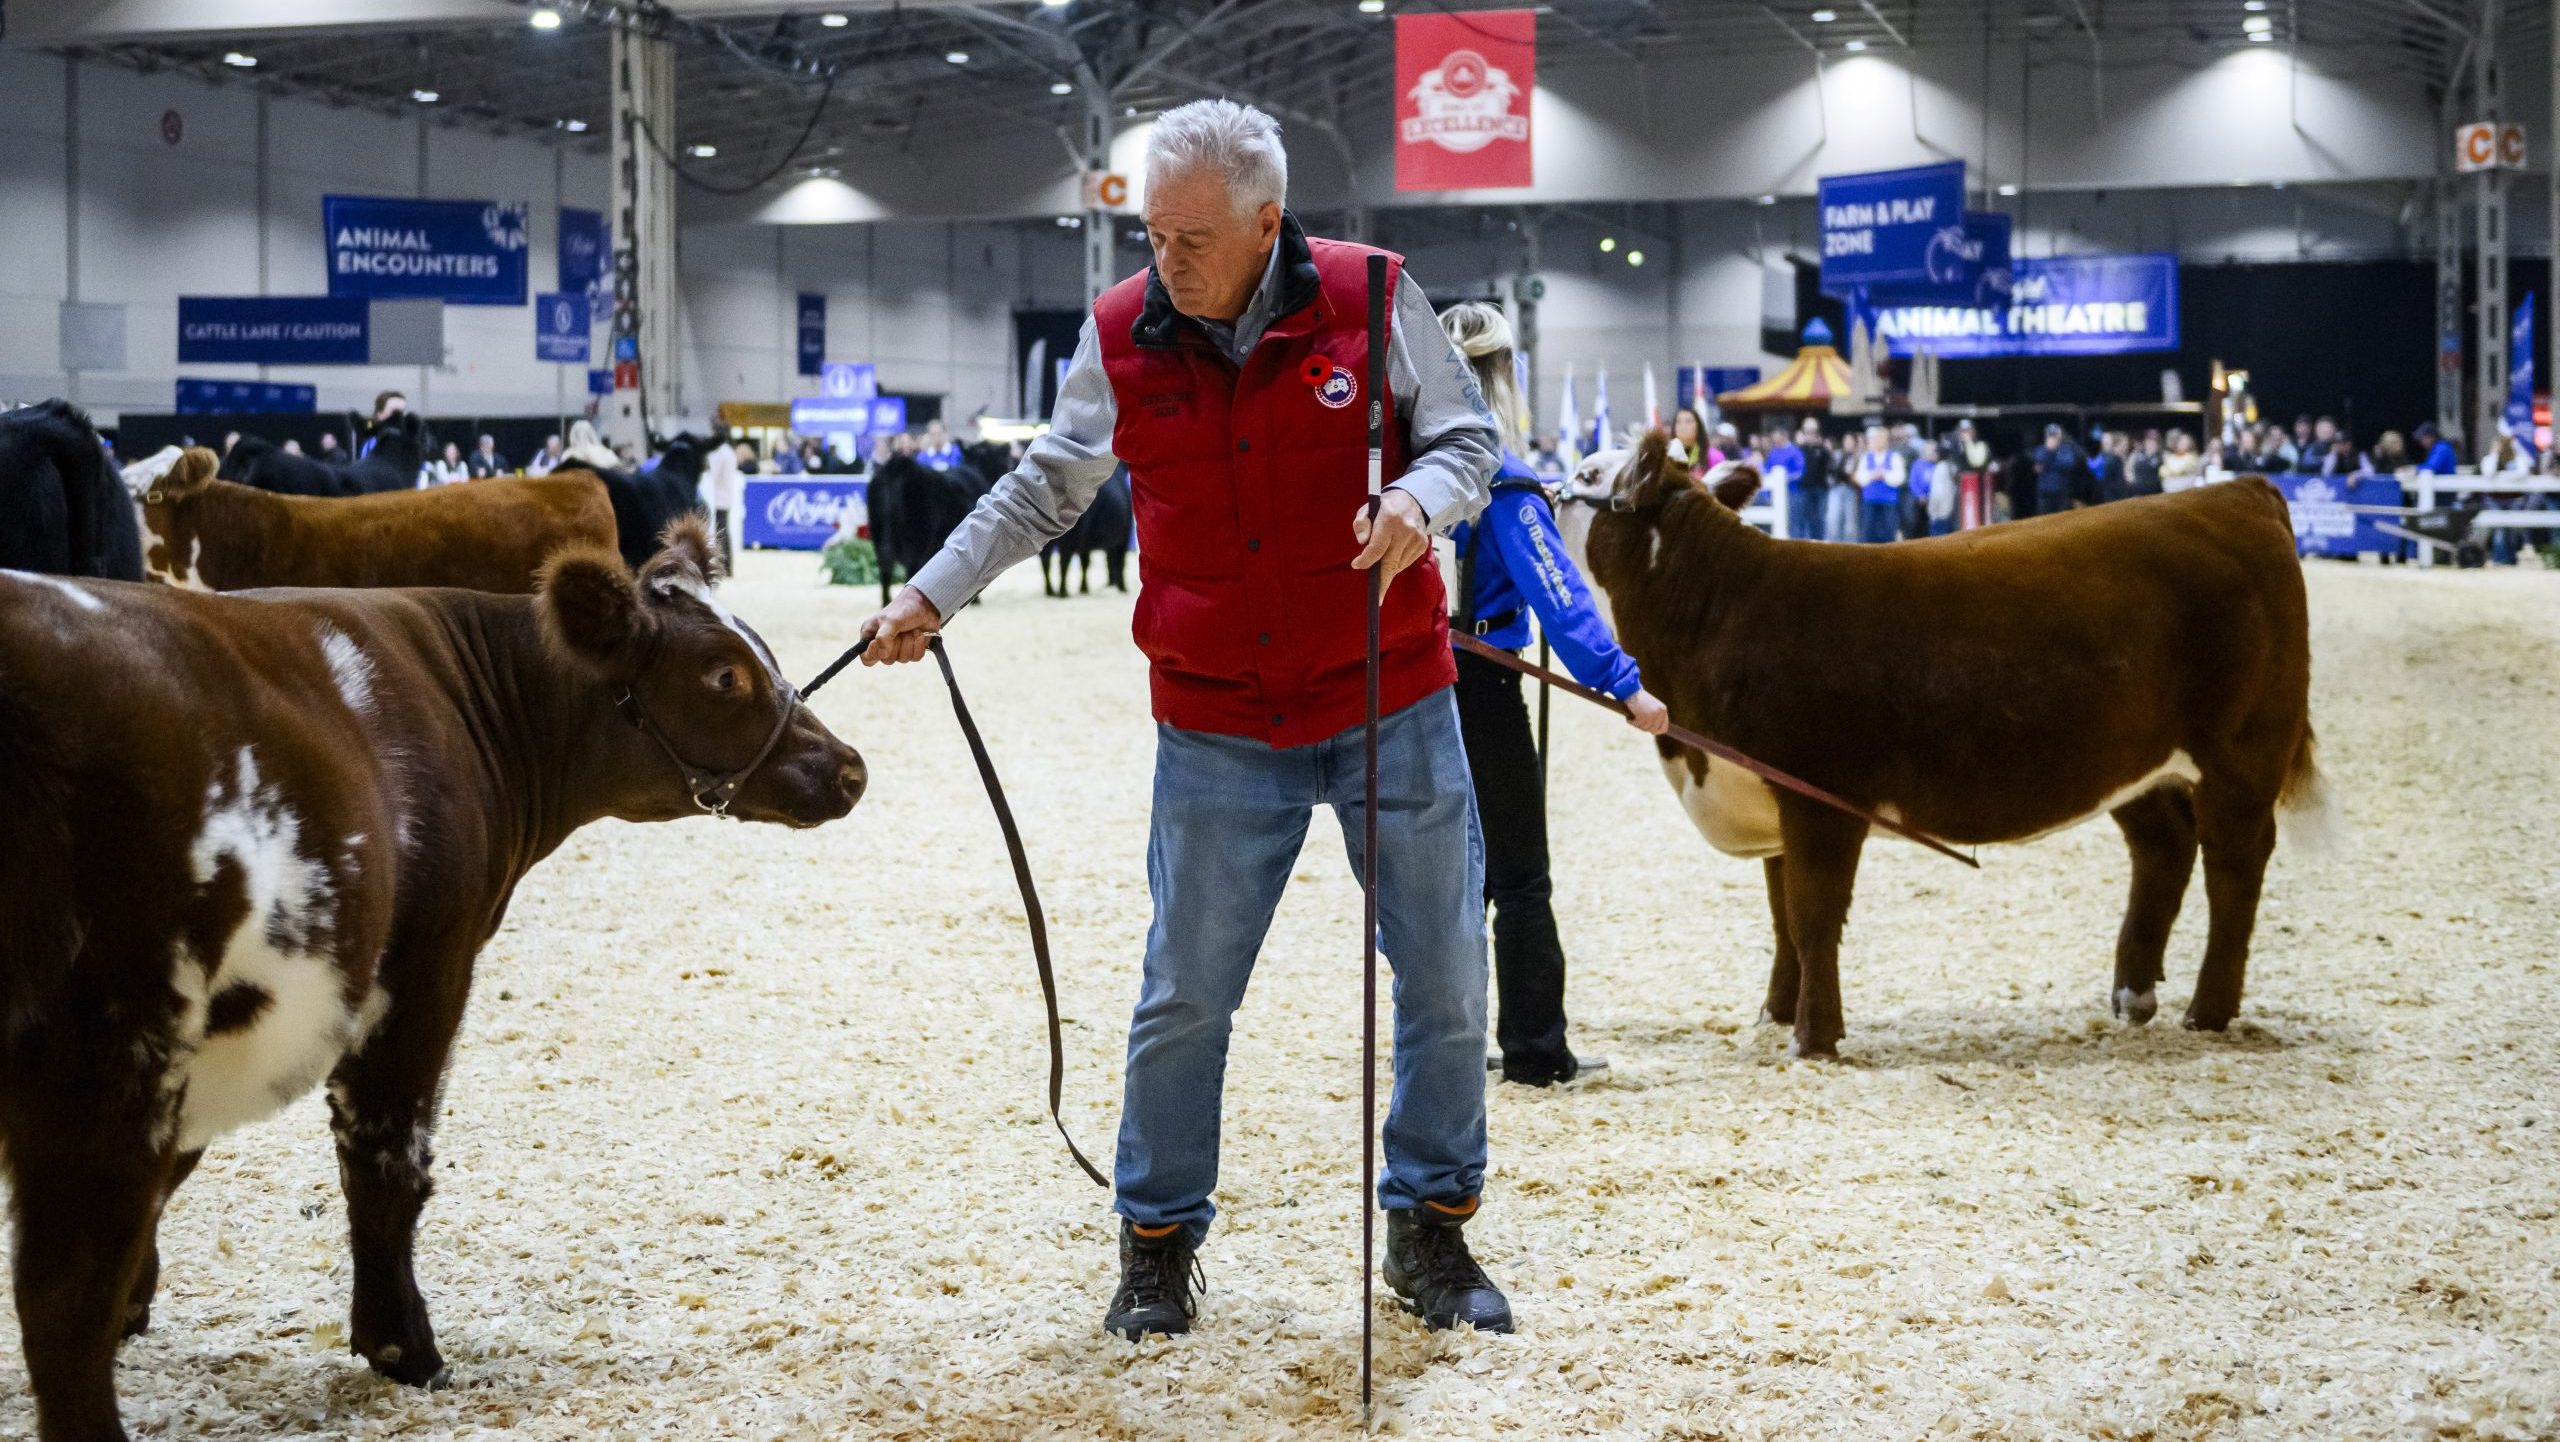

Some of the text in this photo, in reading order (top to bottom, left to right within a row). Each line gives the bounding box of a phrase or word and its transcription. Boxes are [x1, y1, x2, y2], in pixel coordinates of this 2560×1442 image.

[2467, 128, 2493, 164] C
[2500, 128, 2525, 164] C
[1101, 175, 1127, 206] C
[1825, 203, 1874, 229] FARM
[1891, 196, 1935, 224] PLAY
[336, 227, 431, 251] ANIMAL
[1825, 230, 1874, 257] ZONE
[337, 251, 499, 278] ENCOUNTERS
[185, 322, 238, 340] CATTLE
[241, 323, 281, 340] LANE
[293, 322, 361, 339] CAUTION
[1876, 301, 2147, 337] ANIMAL THEATRE
